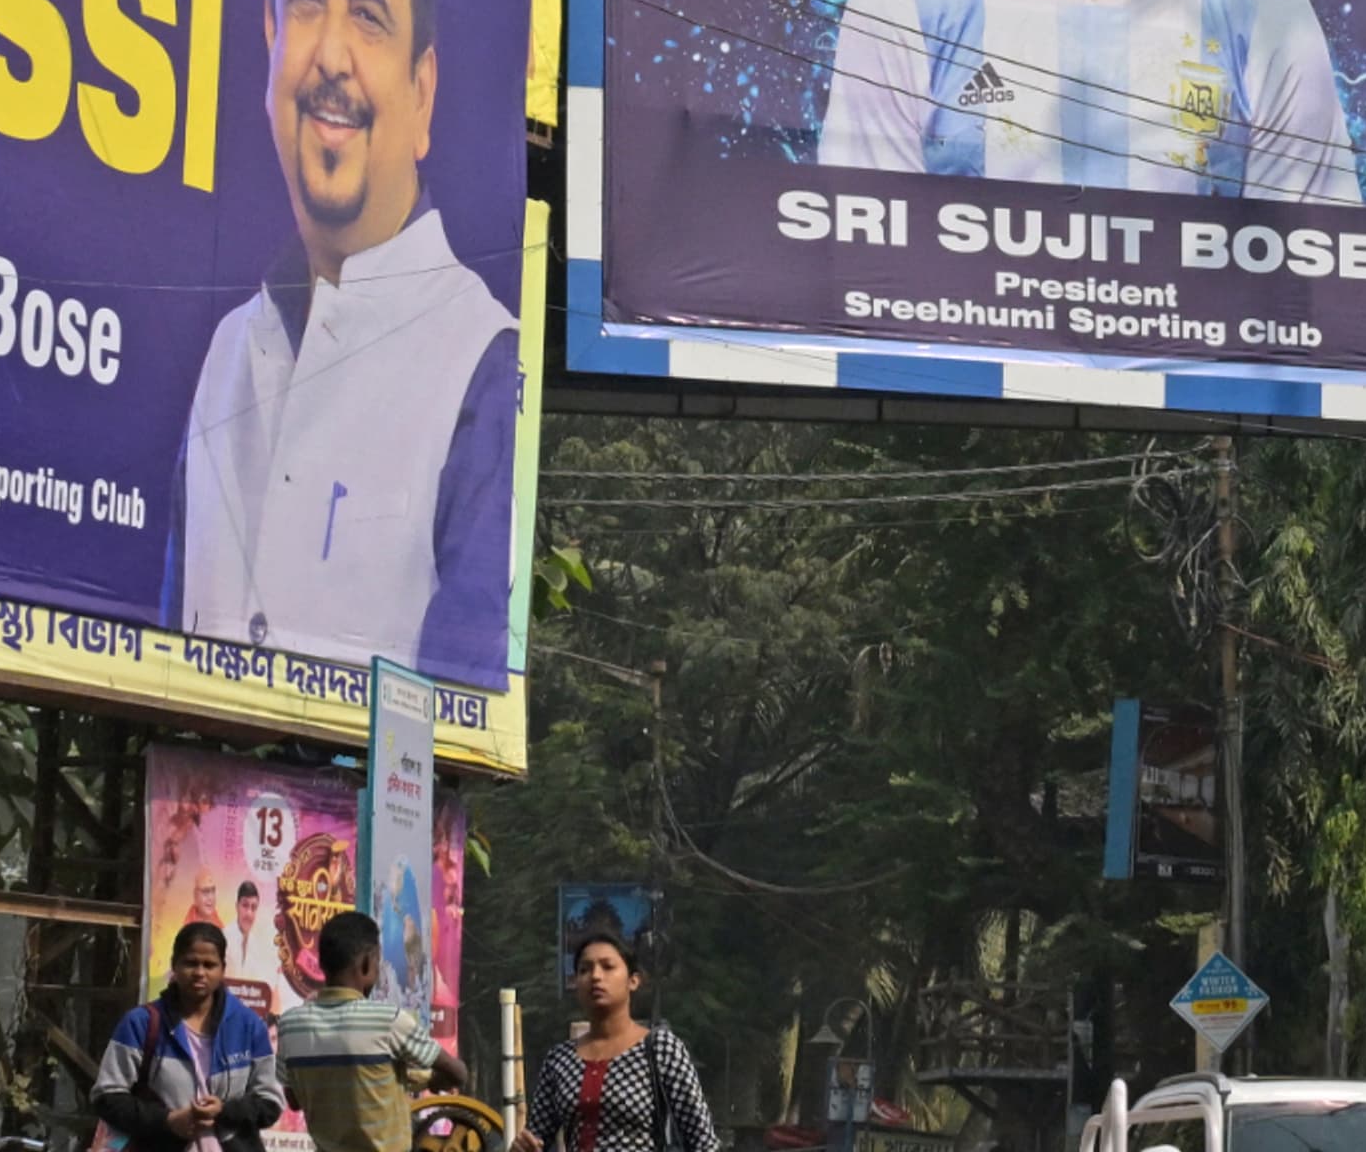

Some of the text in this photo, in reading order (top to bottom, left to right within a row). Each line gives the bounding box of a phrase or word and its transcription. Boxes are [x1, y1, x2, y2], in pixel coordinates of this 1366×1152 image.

[958, 84, 1015, 107] adidas
[776, 189, 909, 247] SRI
[937, 203, 1155, 264] SUJIT
[995, 271, 1178, 307] President
[844, 291, 1323, 348] Sreebhumi Sporting Club
[90, 476, 147, 529] Club
[255, 805, 284, 848] 13
